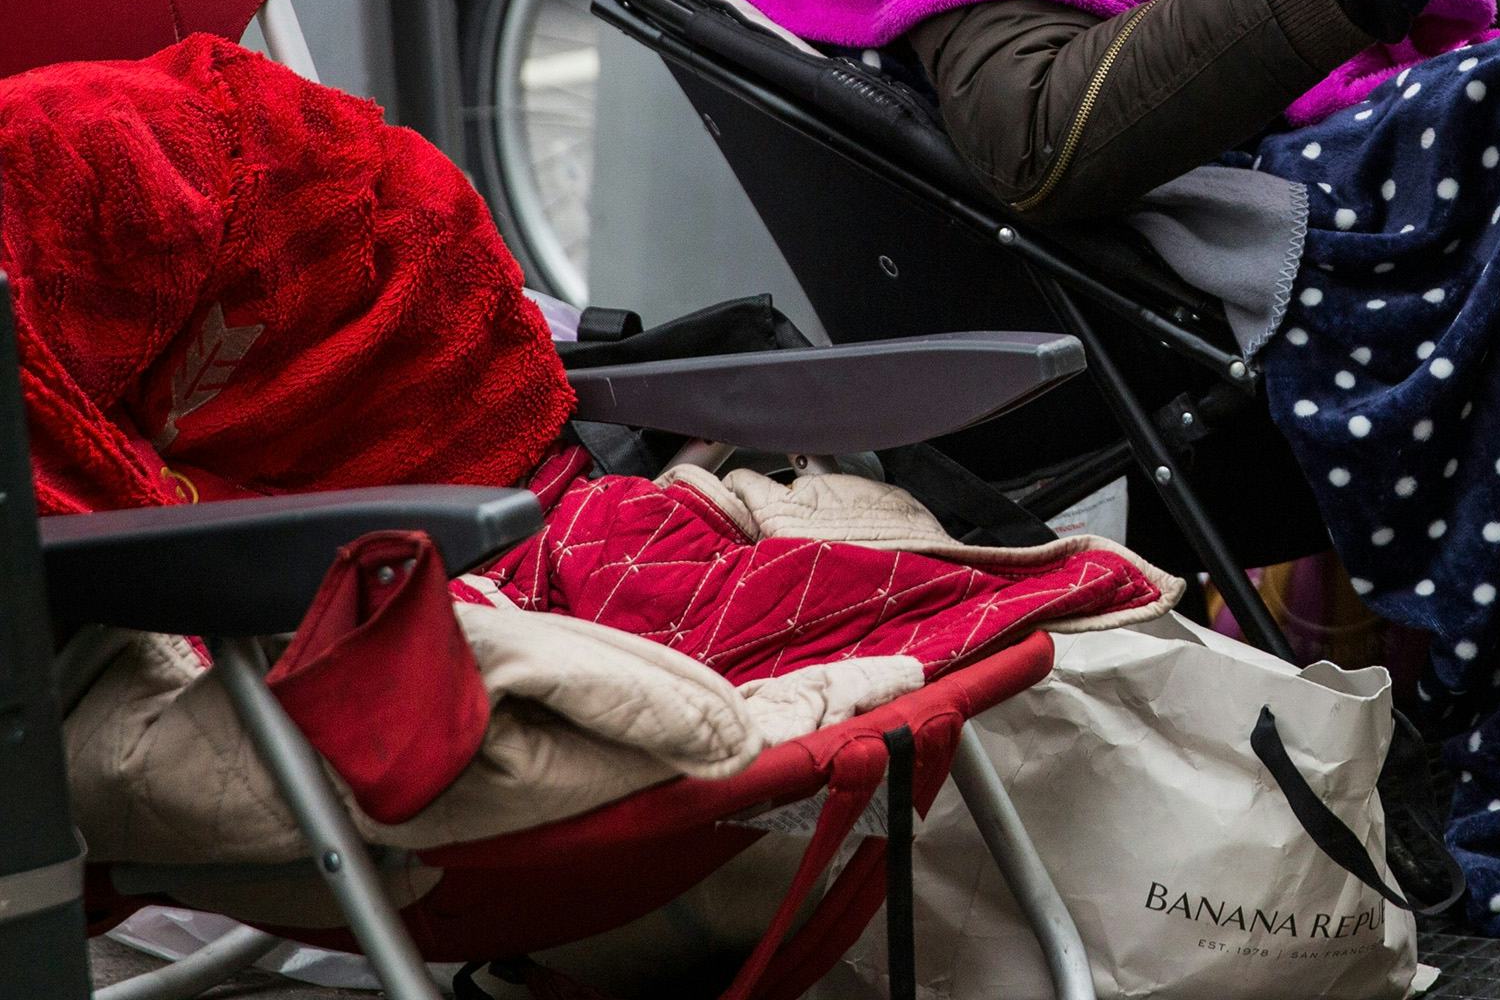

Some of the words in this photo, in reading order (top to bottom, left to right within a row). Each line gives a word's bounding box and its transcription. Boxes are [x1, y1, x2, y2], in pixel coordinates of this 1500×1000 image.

[1144, 880, 1298, 938] BANANA
[1310, 897, 1386, 939] REPU
[1198, 939, 1230, 954] EST.
[1237, 946, 1269, 959] 1978
[1289, 950, 1319, 960] SAN
